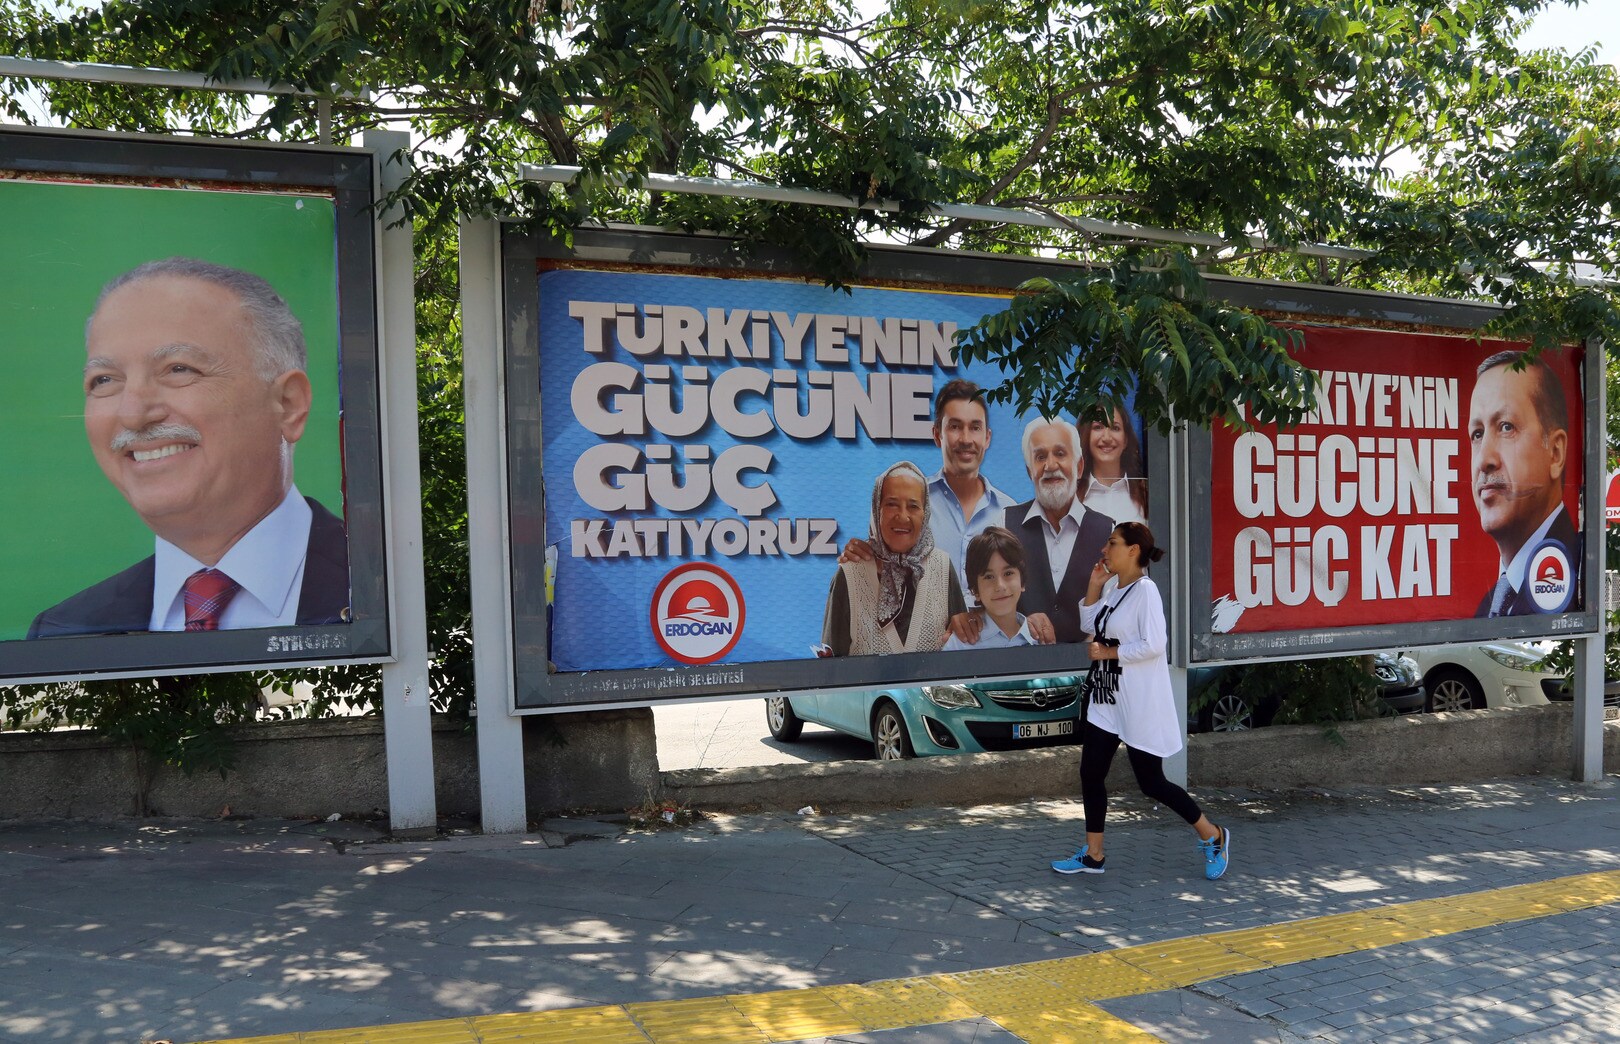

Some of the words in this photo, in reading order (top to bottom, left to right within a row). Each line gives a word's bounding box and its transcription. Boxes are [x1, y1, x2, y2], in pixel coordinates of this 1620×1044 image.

[570, 361, 935, 440] GÜCÜNE
[572, 442, 778, 517] GÜÇ
[1232, 431, 1459, 519] GÜCÜNE
[570, 517, 839, 558] KATIYORUZ
[1233, 524, 1350, 608] GÜÇ
[1360, 523, 1460, 601] KAT
[1019, 725, 1031, 737] 06
[1058, 721, 1072, 733] 100
